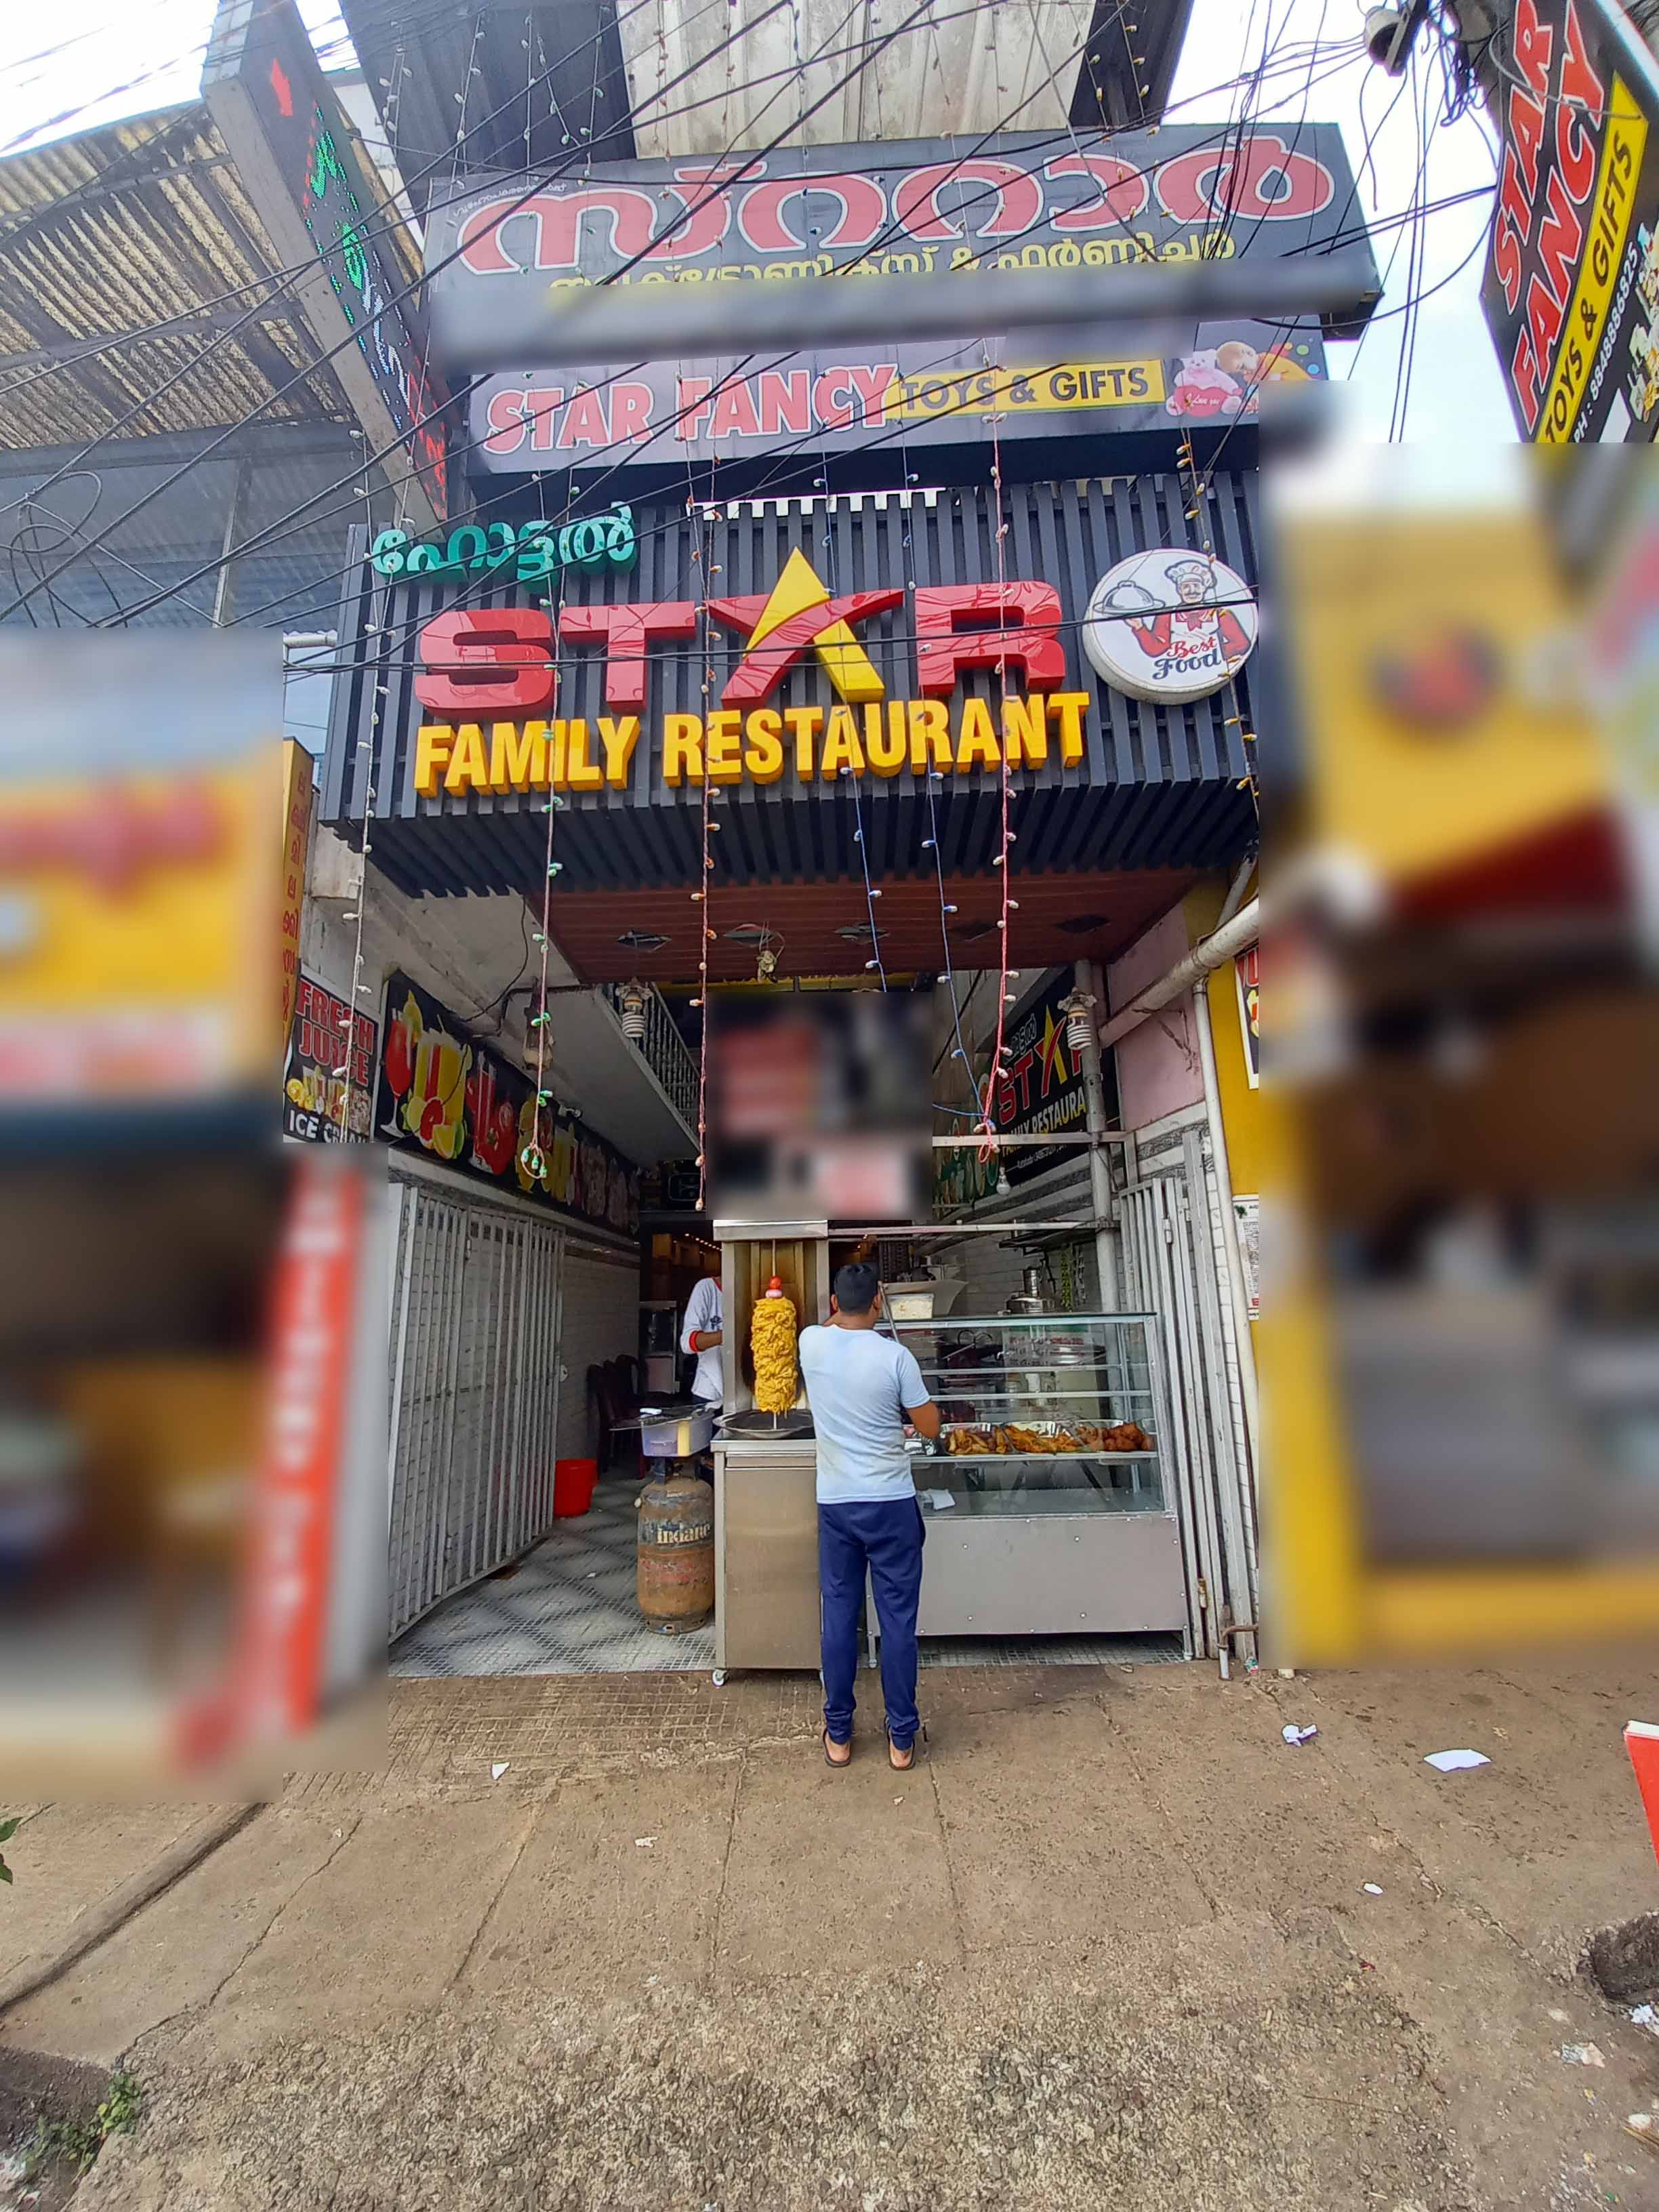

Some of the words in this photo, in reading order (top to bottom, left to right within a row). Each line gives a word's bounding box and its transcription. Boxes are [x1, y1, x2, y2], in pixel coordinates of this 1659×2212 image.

[1494, 0, 1553, 315] STAR
[1512, 0, 1604, 434] FANCY
[1580, 298, 1597, 341] &
[1593, 129, 1632, 287] GIFTS
[484, 381, 655, 455] STAR
[674, 363, 899, 443] FANCY
[901, 374, 995, 411] TOYS
[1008, 373, 1038, 405] &
[1050, 367, 1149, 401] GIFTS
[414, 545, 1066, 719] STAR
[1152, 649, 1222, 680] Food
[1167, 636, 1217, 658] Best
[414, 716, 640, 798] FAMILY
[663, 692, 1089, 789] RESTAURANT
[295, 978, 374, 1054] FRESH
[299, 1019, 369, 1087] JUICE
[289, 1109, 319, 1139] ICE
